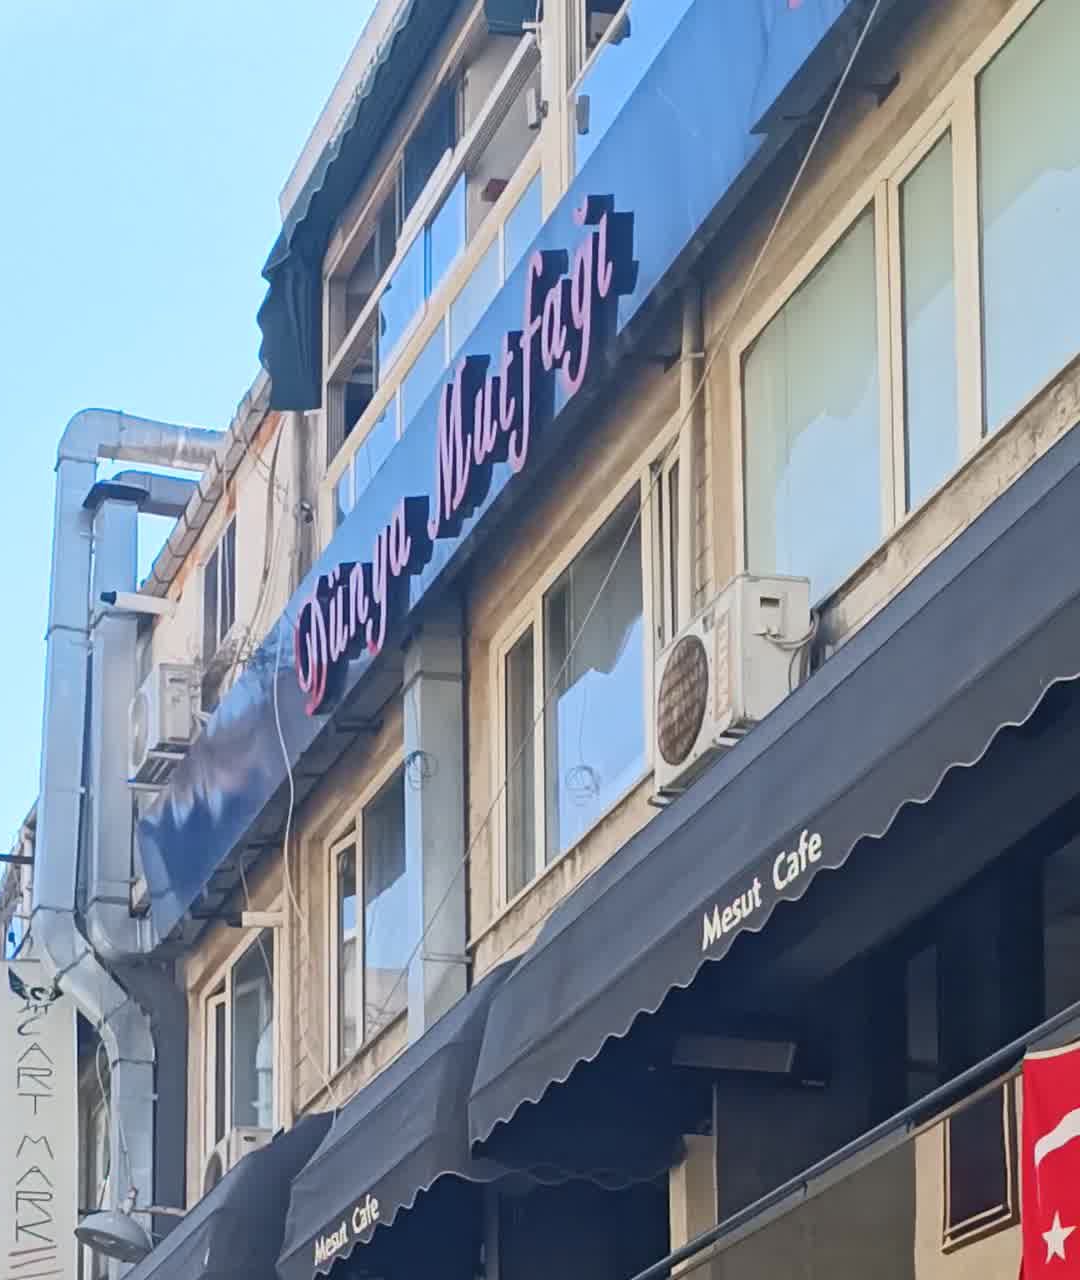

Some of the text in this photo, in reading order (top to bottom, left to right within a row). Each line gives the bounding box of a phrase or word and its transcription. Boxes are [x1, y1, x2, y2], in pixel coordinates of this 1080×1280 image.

[294, 200, 612, 716] Dünya Mutfağı
[702, 829, 822, 951] Mesut Cafe
[352, 1193, 379, 1234] Cafe
